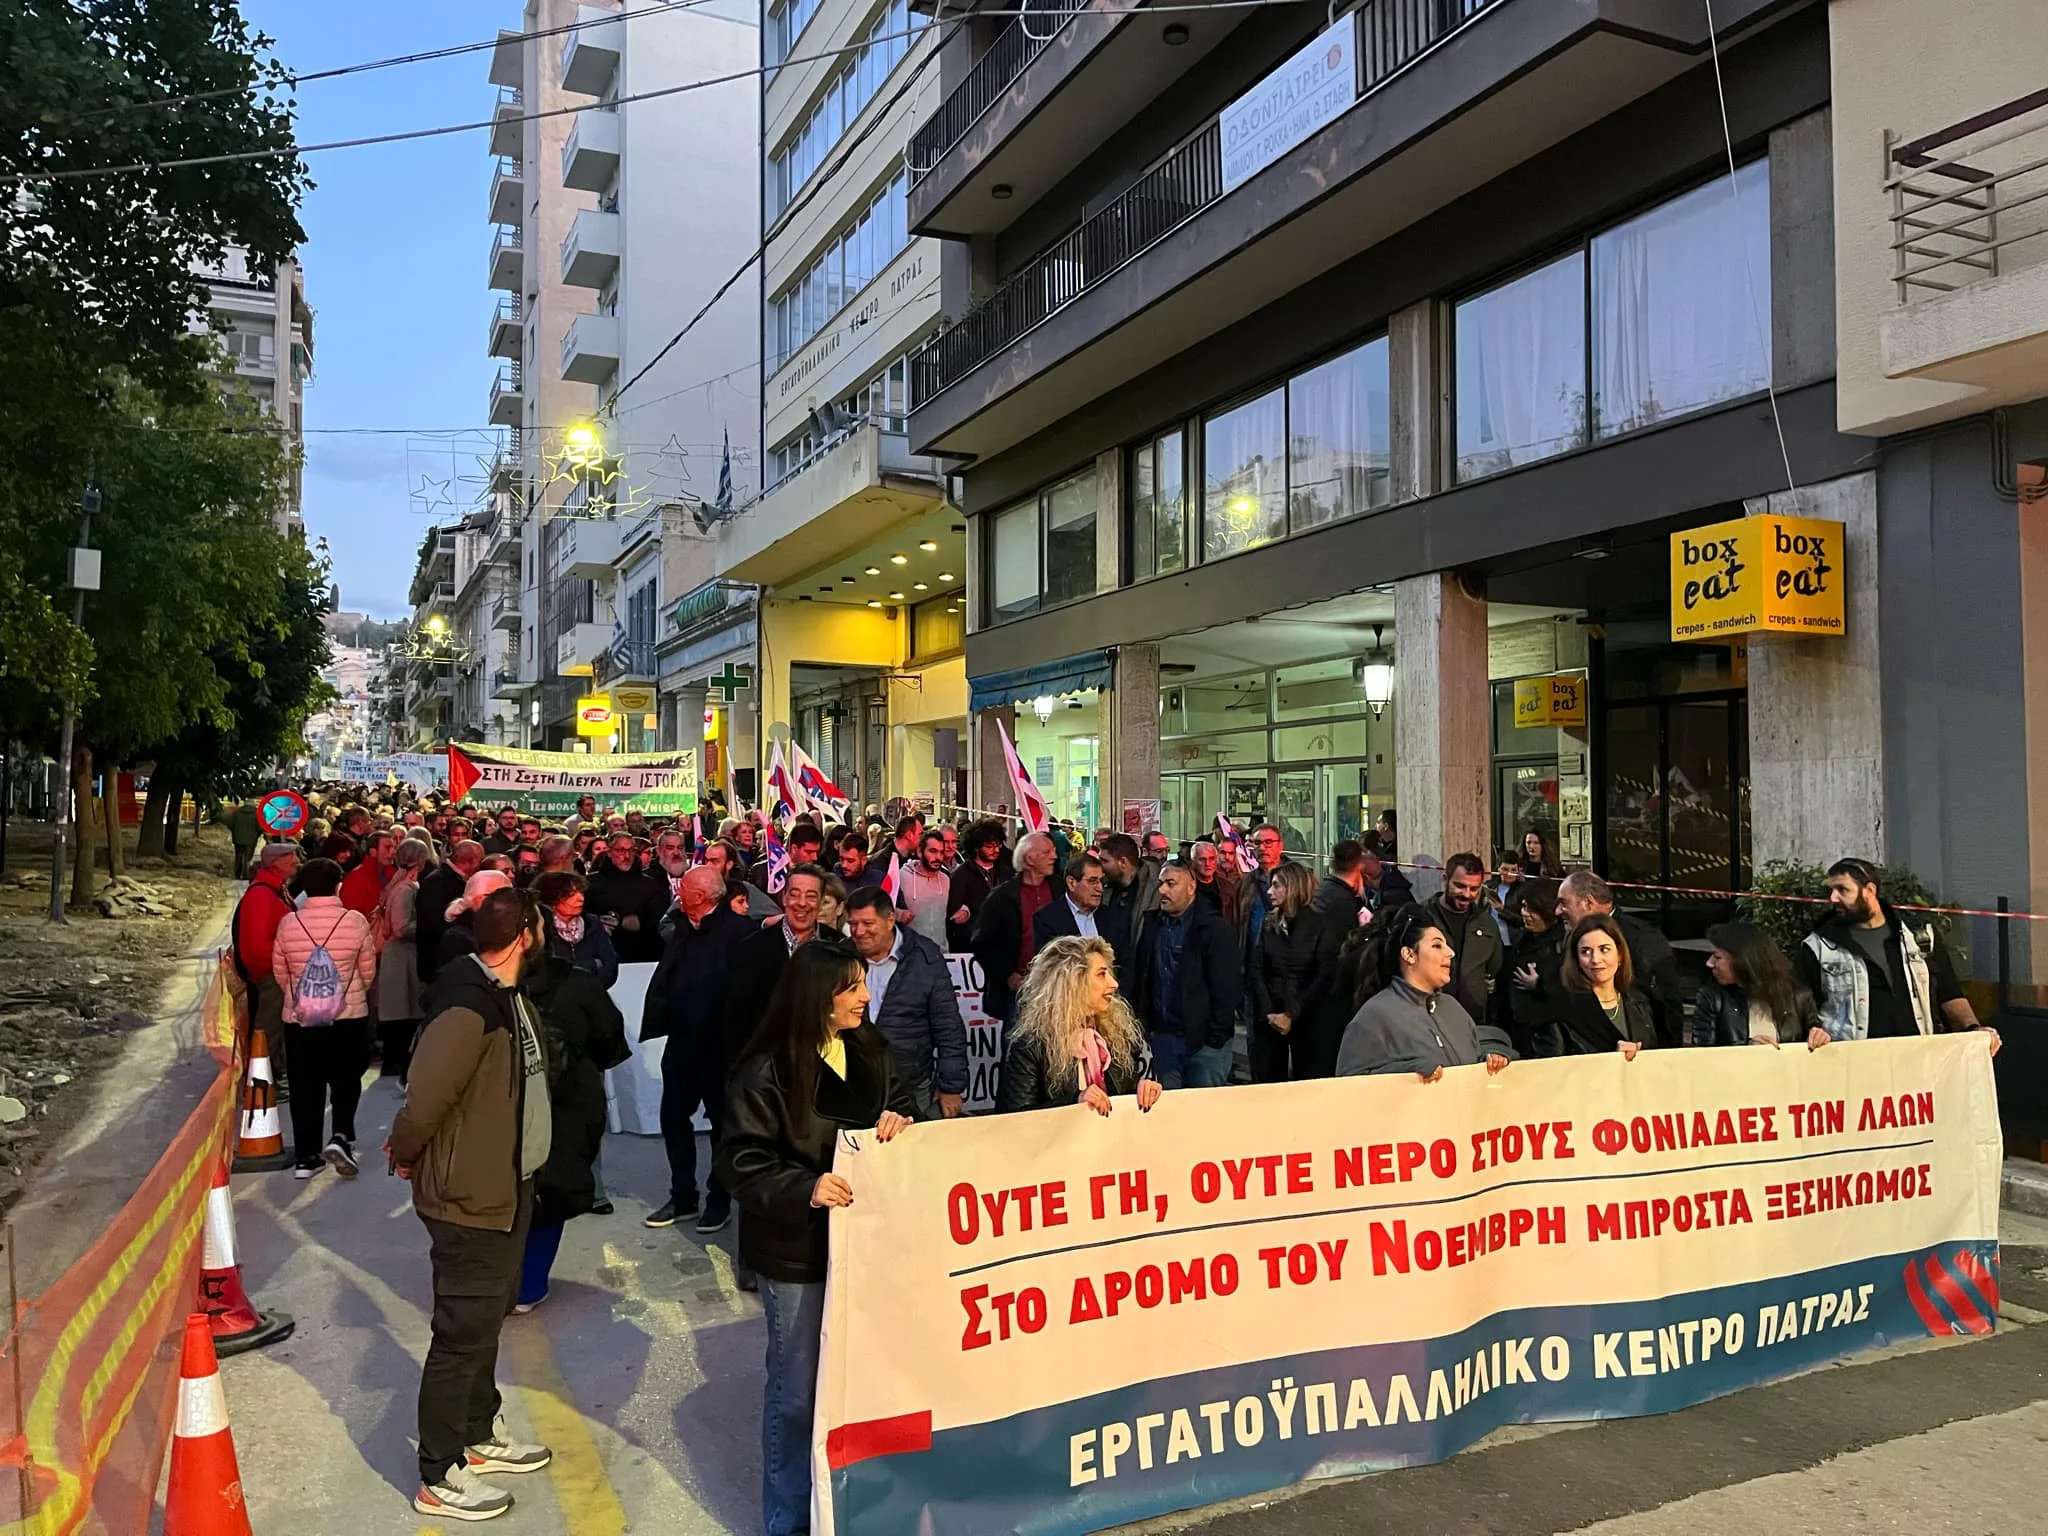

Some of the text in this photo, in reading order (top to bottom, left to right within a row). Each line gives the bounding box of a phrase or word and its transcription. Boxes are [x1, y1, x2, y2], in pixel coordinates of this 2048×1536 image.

[890, 256, 923, 299] ΠΑΤΡΑΣ
[1681, 537, 1739, 566] box
[1773, 524, 1826, 561] box
[1683, 557, 1745, 611] eat
[1775, 556, 1832, 600] eat
[1676, 621, 1705, 636] crepes
[1712, 613, 1756, 630] sandwich
[1768, 613, 1796, 627] crepes
[1803, 615, 1841, 628] sandwich
[1552, 681, 1577, 695] box
[1553, 694, 1580, 713] eat
[481, 767, 696, 789] ΣΤΗ ΣΩΣΤΗ ΠΛΕΥΡΑ ΤΗΣ ΙΣΤΟΡΙΑΣ
[947, 1091, 1935, 1246] ΟΥΤΕ ΓΗ, ΟΥΤΕ ΝΕΡΟ ΣΤΟΥΣ ΦΟΝΙΑΔΕΣ ΤΩΝ ΛΑΩΝ
[960, 1163, 1933, 1352] ΣΤΟ ΔΡΟΜΟ ΤΟΥ ΝΟΕΜΒΡΗ ΜΠΡΟΣΤΑ ΞΕΣΗΚΩΜΟΣ
[1069, 1283, 1875, 1488] ΕΡΓΑΤΟΫΠΑΛΛΗΛΙΚΟ ΚΕΝΤΡΟ ΠΑΤΡΑΣ
